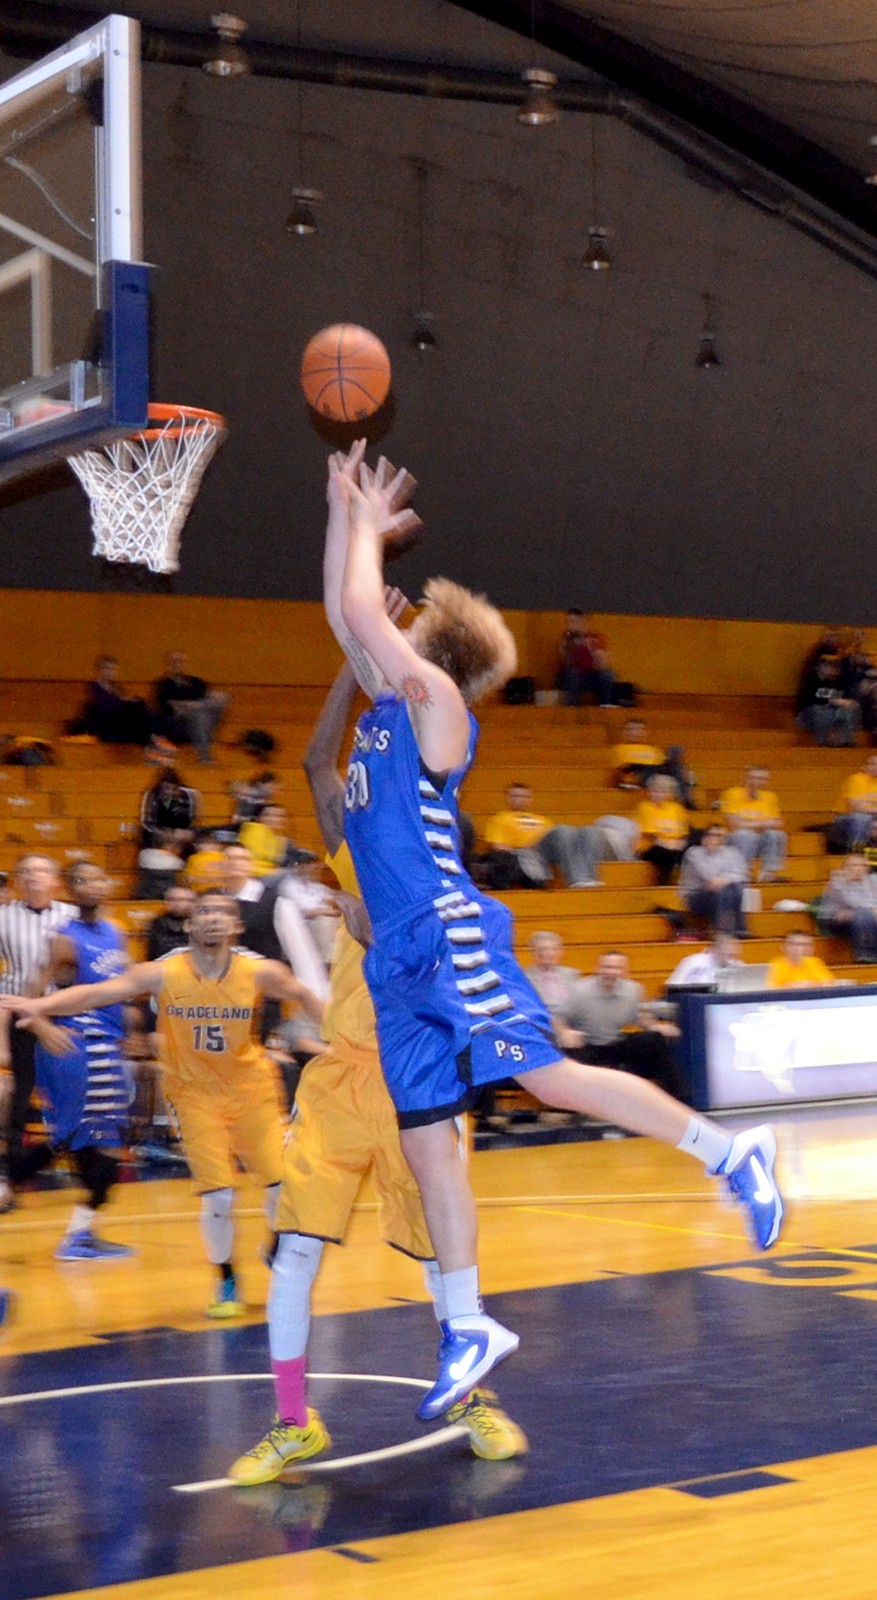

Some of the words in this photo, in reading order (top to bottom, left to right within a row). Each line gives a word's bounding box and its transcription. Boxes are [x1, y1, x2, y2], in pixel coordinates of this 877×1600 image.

[345, 761, 369, 808] 30
[167, 1005, 251, 1020] GRACELAND
[192, 1024, 225, 1053] 15
[494, 1040, 524, 1062] PS
